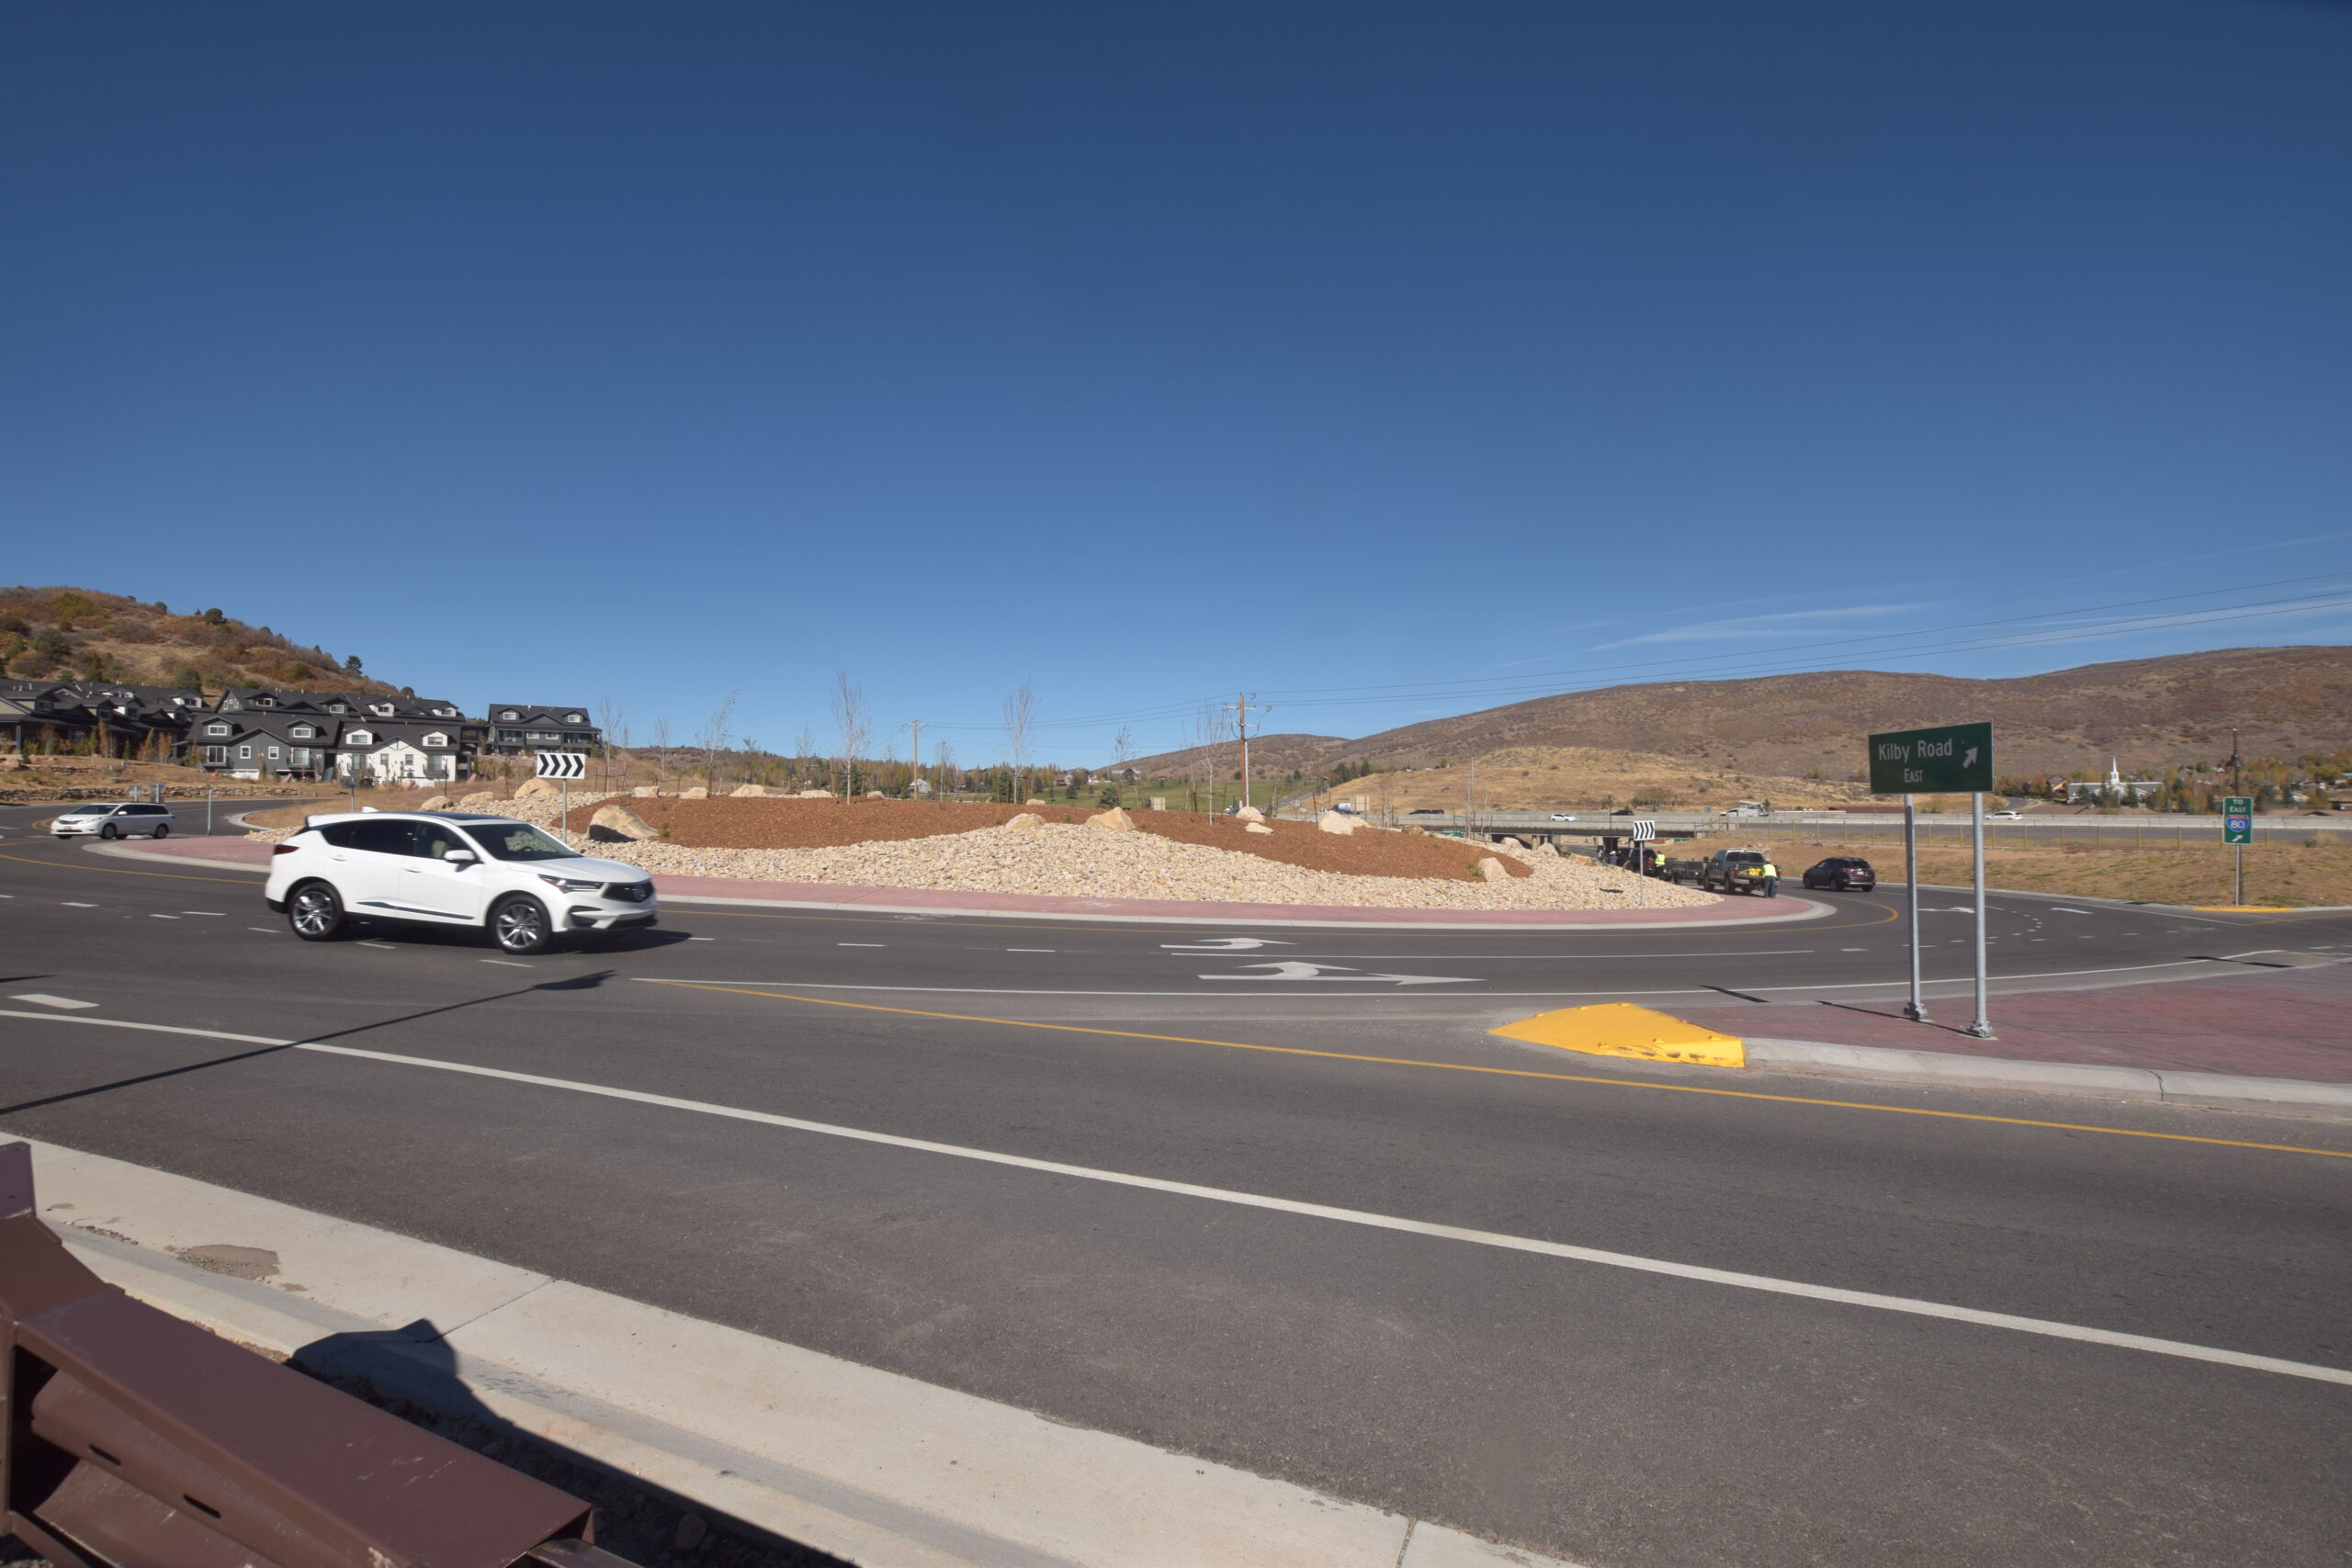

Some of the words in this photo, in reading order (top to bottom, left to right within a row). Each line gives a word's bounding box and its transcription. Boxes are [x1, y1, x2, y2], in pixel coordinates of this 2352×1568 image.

[1879, 743, 1910, 763] Kilby
[1917, 739, 1952, 758] Road
[1904, 768, 1924, 783] EAST
[2231, 820, 2245, 829] 80
